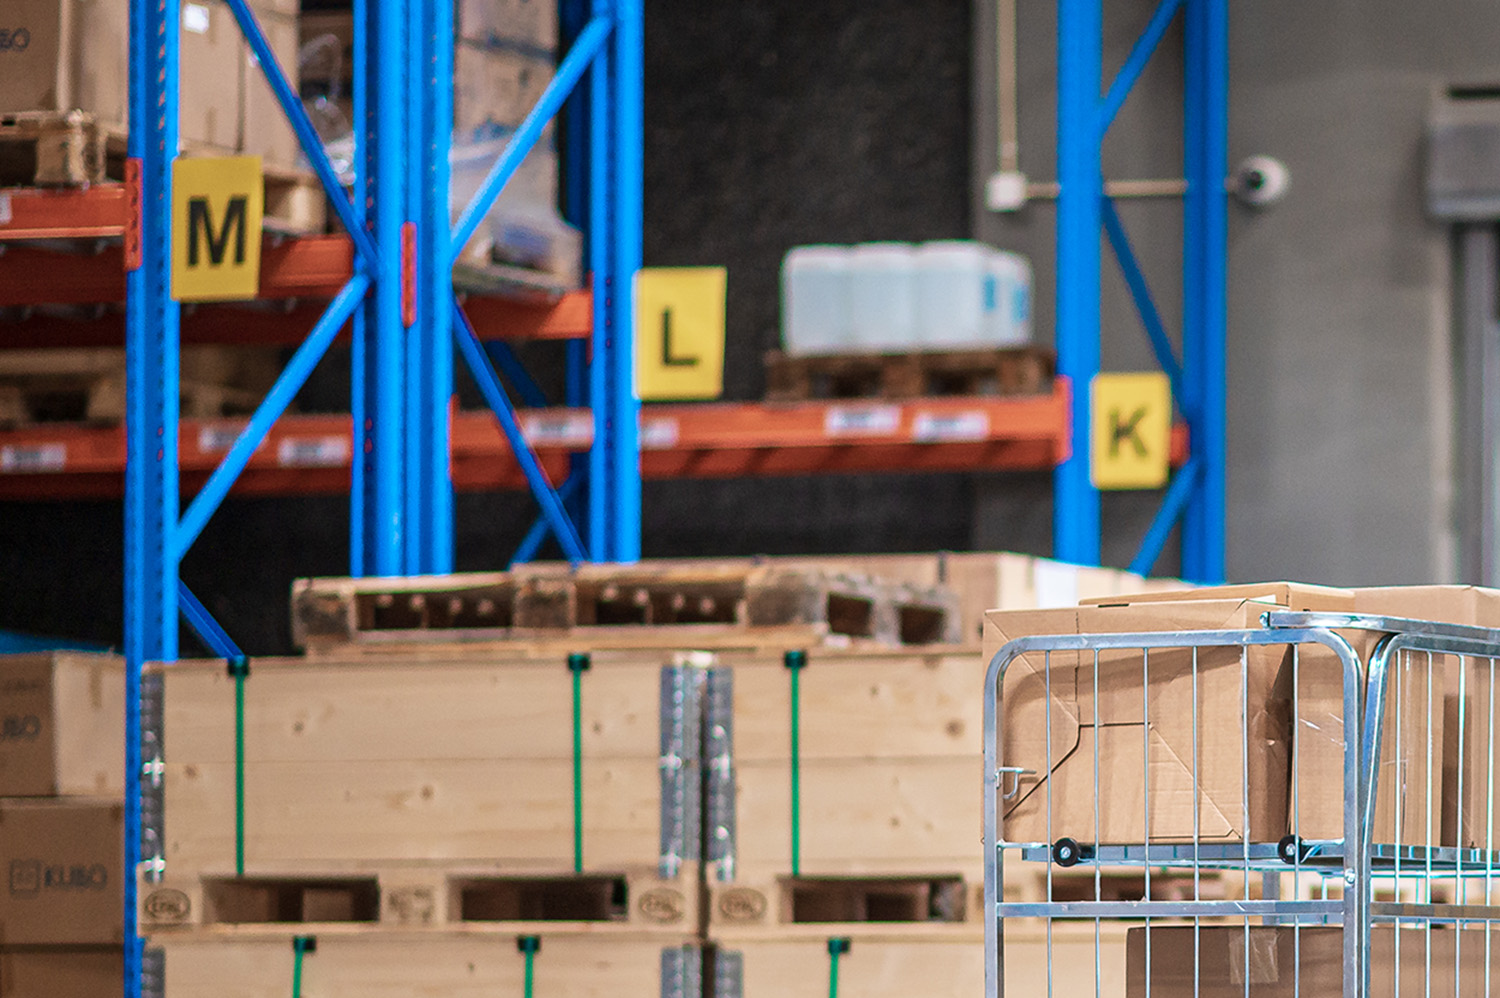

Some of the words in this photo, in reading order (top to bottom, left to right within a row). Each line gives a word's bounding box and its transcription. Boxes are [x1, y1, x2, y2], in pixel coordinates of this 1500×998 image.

[187, 196, 247, 267] M
[662, 307, 699, 368] L
[1108, 409, 1151, 459] K
